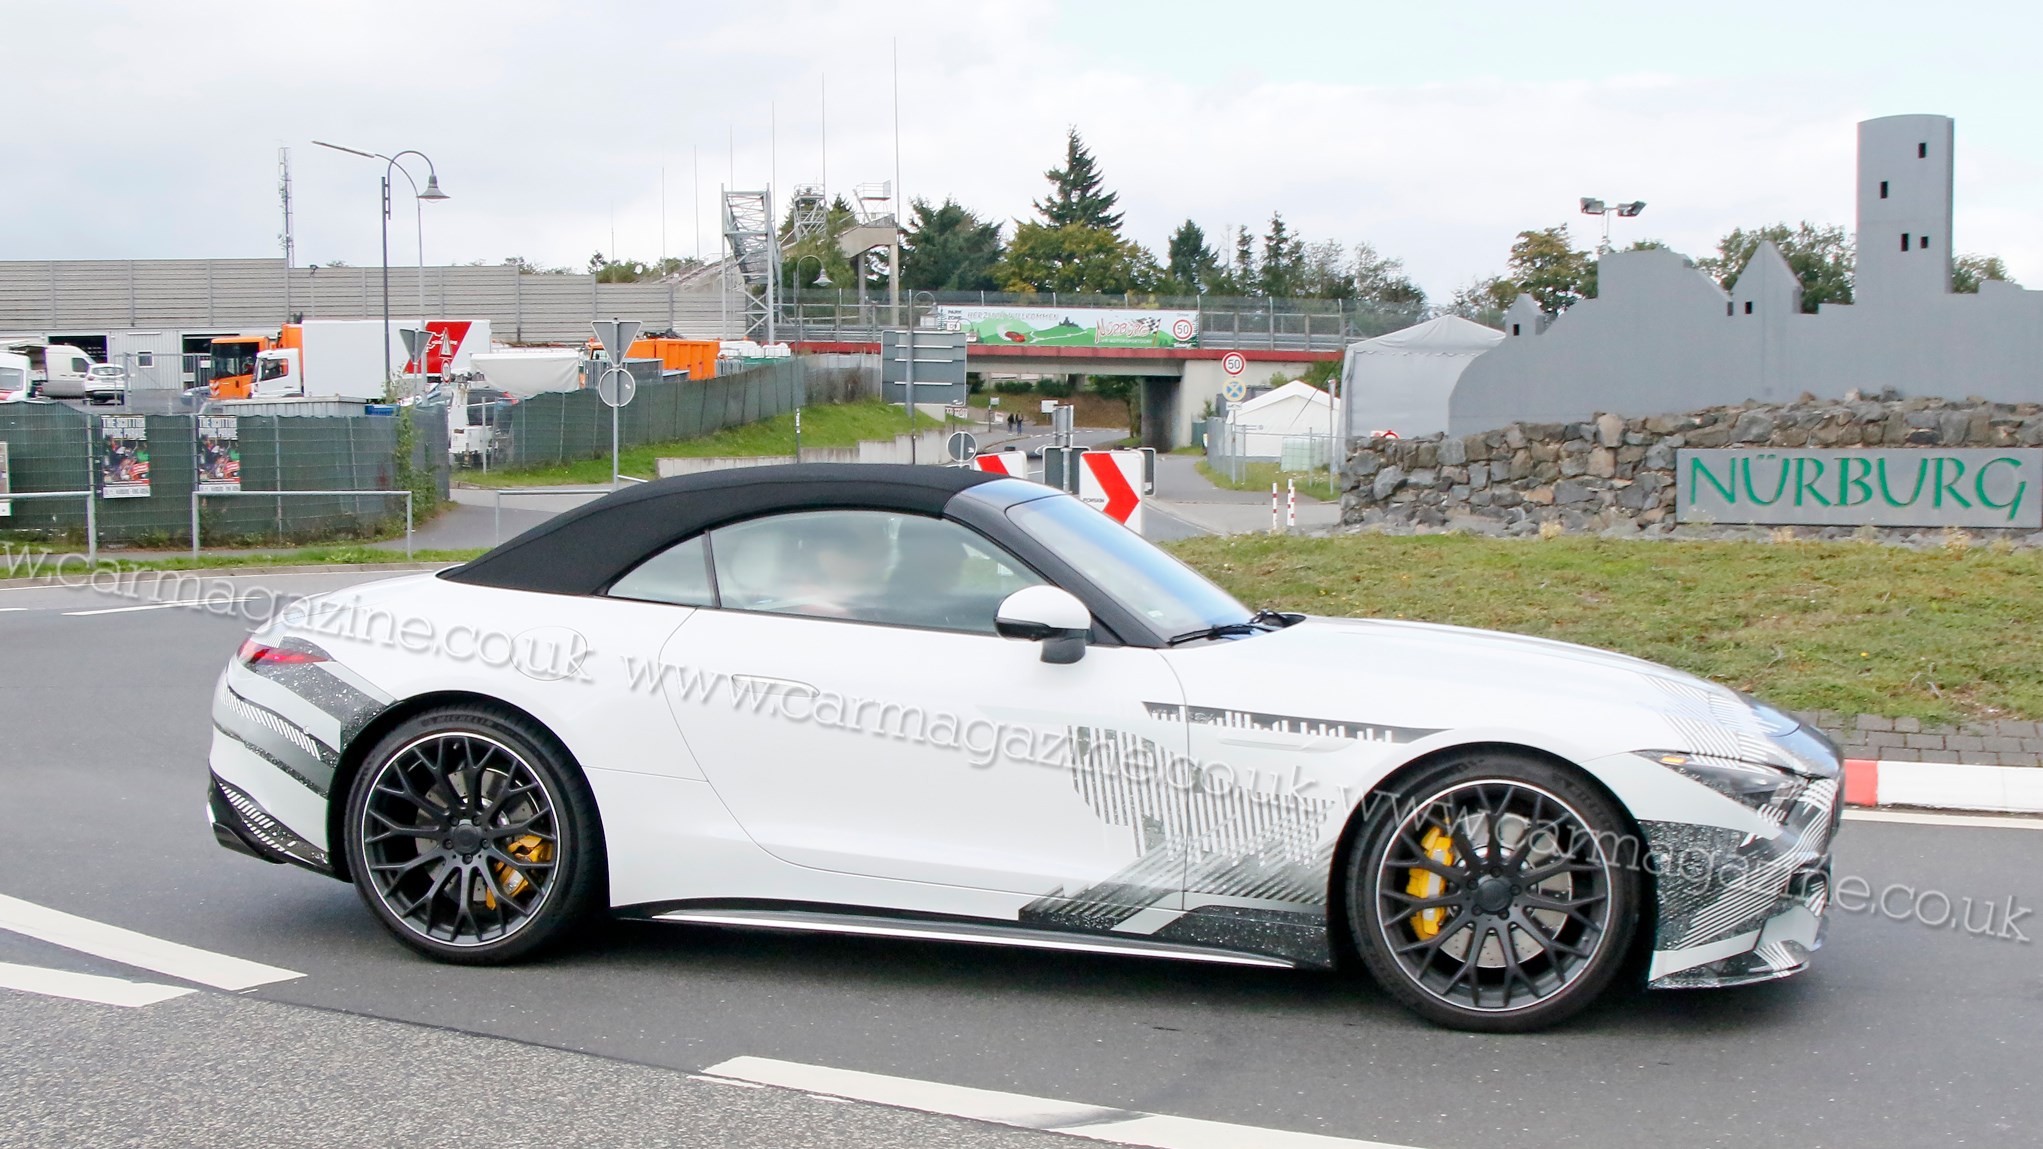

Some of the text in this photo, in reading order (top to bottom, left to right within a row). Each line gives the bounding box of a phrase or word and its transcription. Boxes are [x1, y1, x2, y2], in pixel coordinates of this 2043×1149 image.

[1177, 325, 1189, 334] 50
[1228, 360, 1240, 369] 50
[1690, 454, 2027, 520] NÜRBURG
